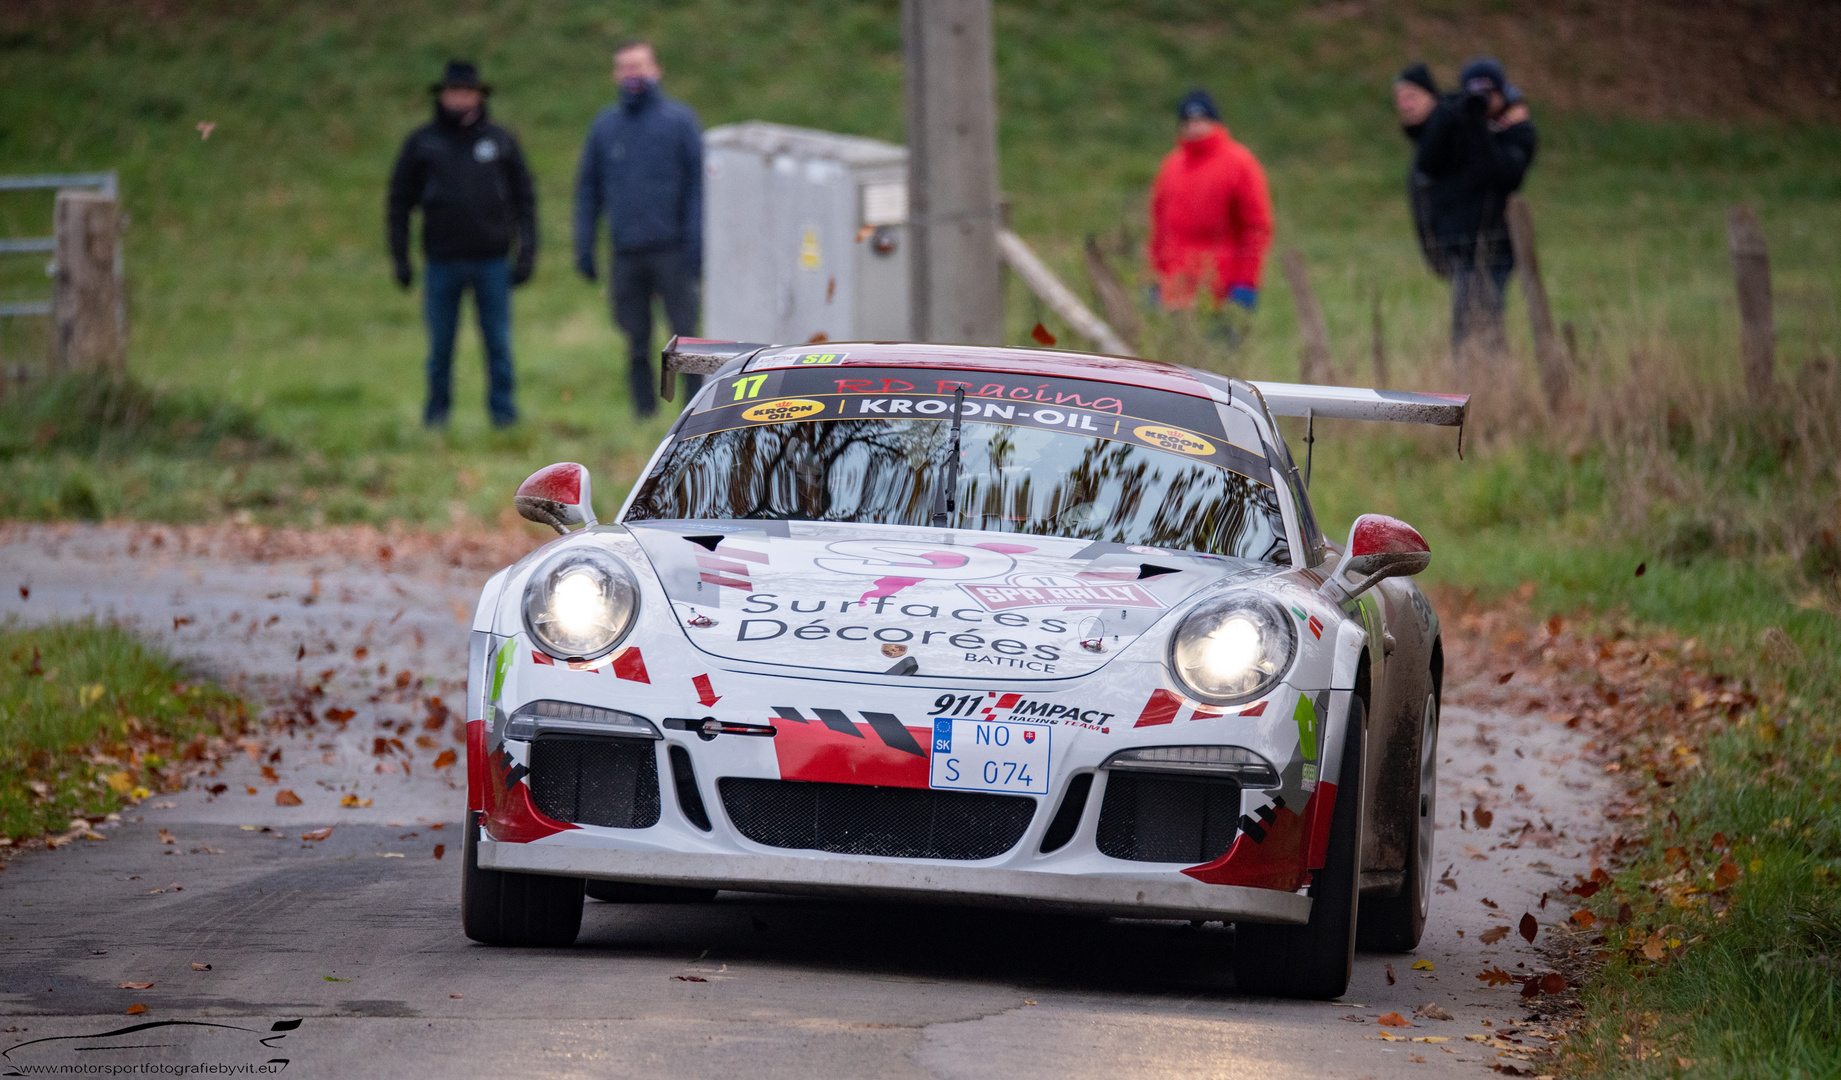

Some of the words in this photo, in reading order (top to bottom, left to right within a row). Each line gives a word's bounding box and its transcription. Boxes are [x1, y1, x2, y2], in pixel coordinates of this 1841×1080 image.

[801, 354, 836, 364] SD
[732, 374, 768, 401] 17
[834, 378, 915, 394] RD
[934, 380, 1122, 415] Racing
[753, 405, 813, 416] KROON
[859, 399, 1098, 432] KROON-OIL
[1145, 430, 1205, 451] KROON
[1159, 440, 1186, 452] OIL
[1032, 576, 1059, 586] 17
[976, 587, 1041, 603] SPA
[1045, 585, 1141, 601] RALLY
[741, 593, 1068, 634] Surfaces
[737, 618, 1061, 661] Décorées
[965, 653, 1056, 674] BATTICE
[927, 693, 984, 717] 911
[1013, 700, 1115, 725] IMPACT
[1008, 715, 1059, 725] RACING
[1064, 720, 1100, 731] TEAM
[936, 739, 950, 750] SK
[976, 724, 1010, 746] NO
[945, 758, 960, 782] S
[983, 760, 1033, 787] 074
